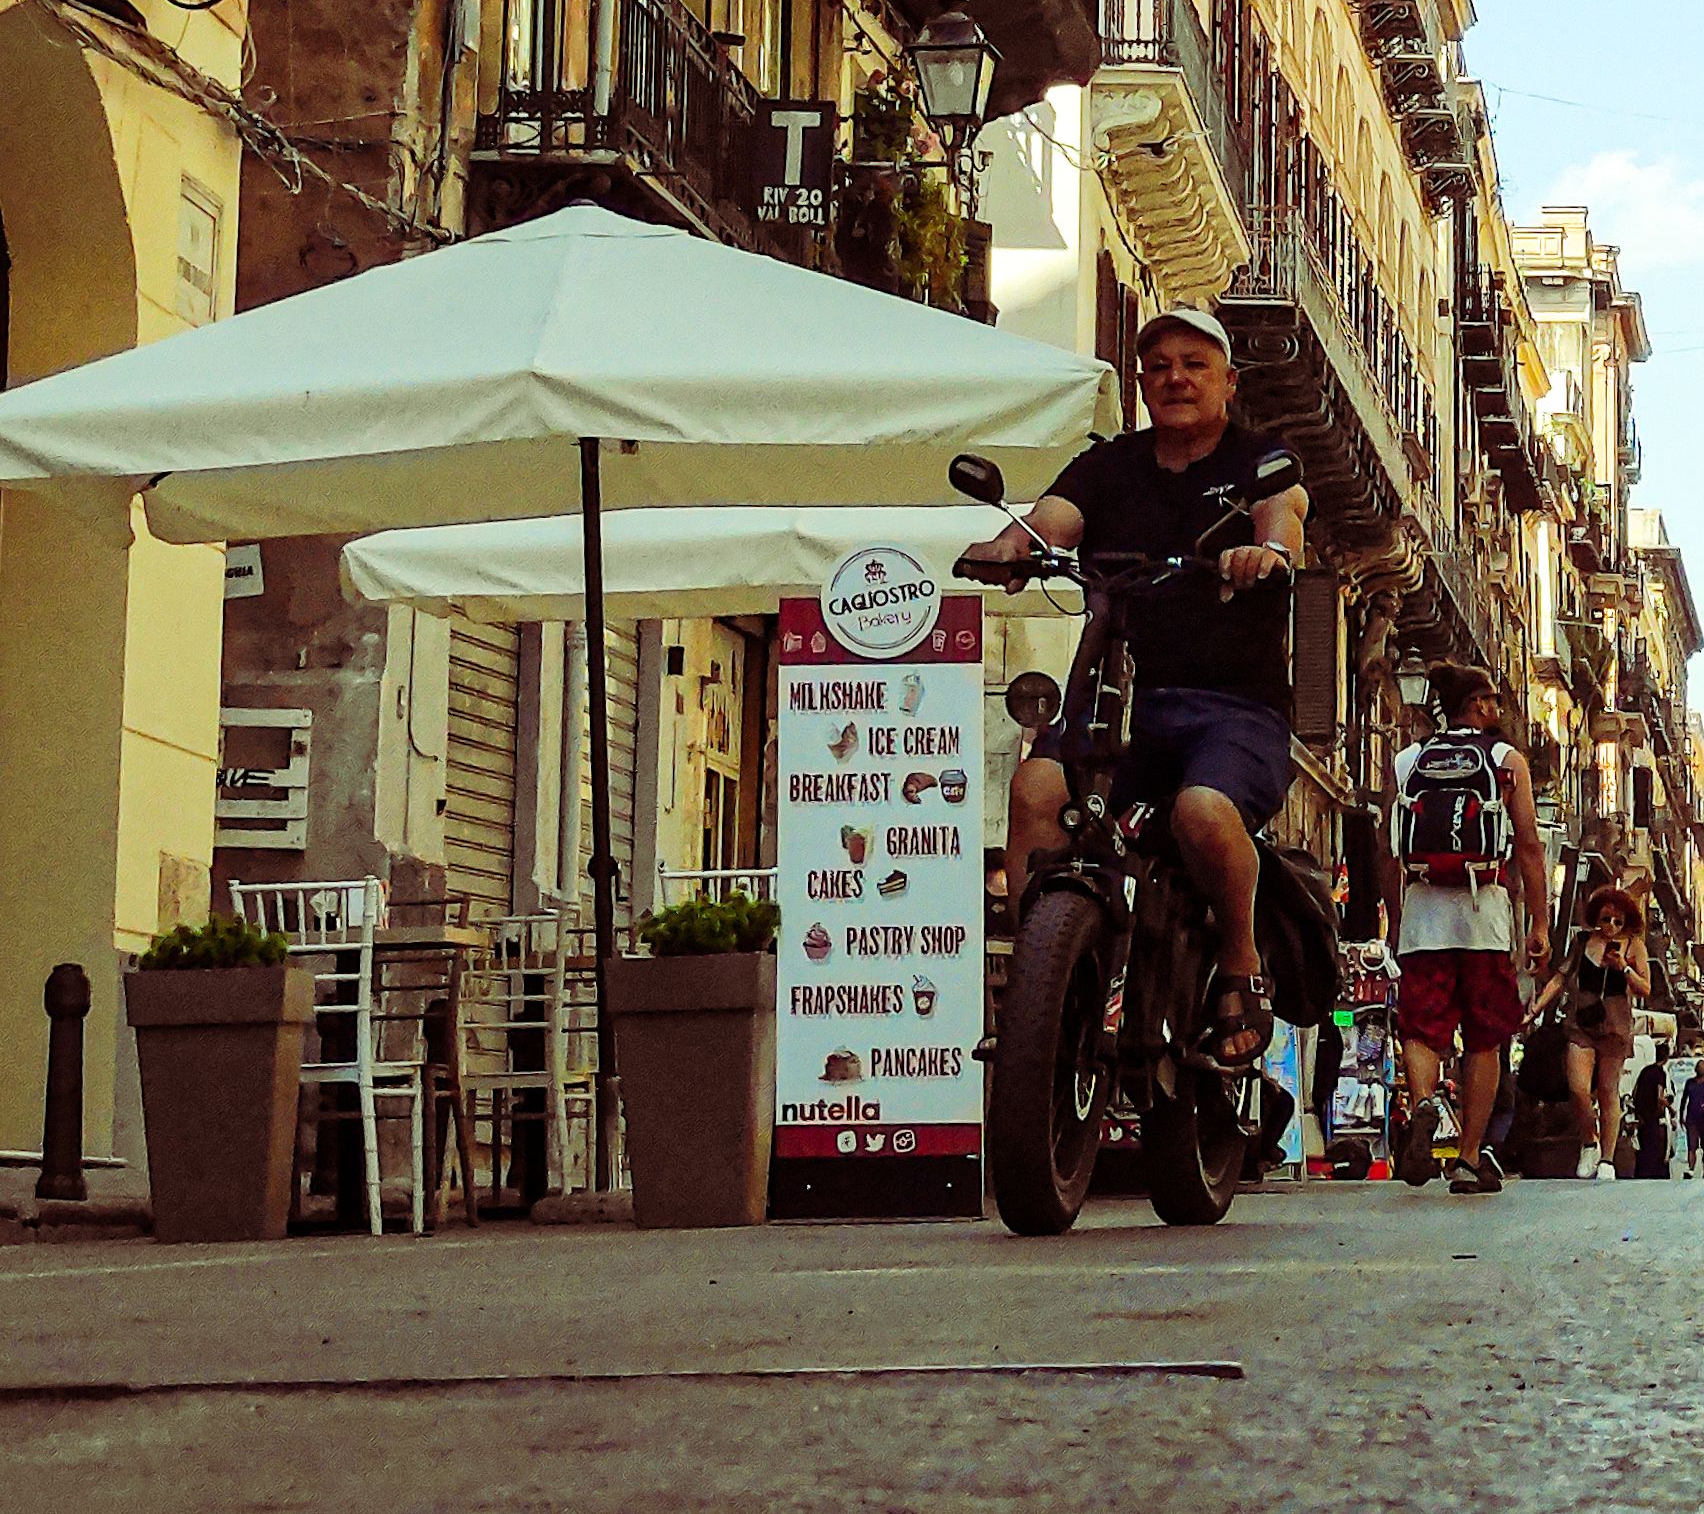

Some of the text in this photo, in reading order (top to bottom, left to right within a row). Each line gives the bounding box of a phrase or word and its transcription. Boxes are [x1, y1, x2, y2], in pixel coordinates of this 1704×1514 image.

[771, 110, 821, 186] T
[795, 188, 822, 206] 20
[828, 579, 935, 615] CAGLIOSTRO
[858, 609, 912, 632] Bakery
[789, 681, 888, 710] MILKSHAKE
[868, 725, 960, 755] ICE CREAM
[789, 772, 892, 802] BREAKFAST
[886, 826, 962, 856] GRANITA
[807, 870, 864, 899] CAKES
[846, 925, 966, 956] PASTRY SHOP
[790, 984, 903, 1015] FRAPSHAKES
[871, 1047, 962, 1077] PANCAKES
[781, 1095, 881, 1122] nutella
